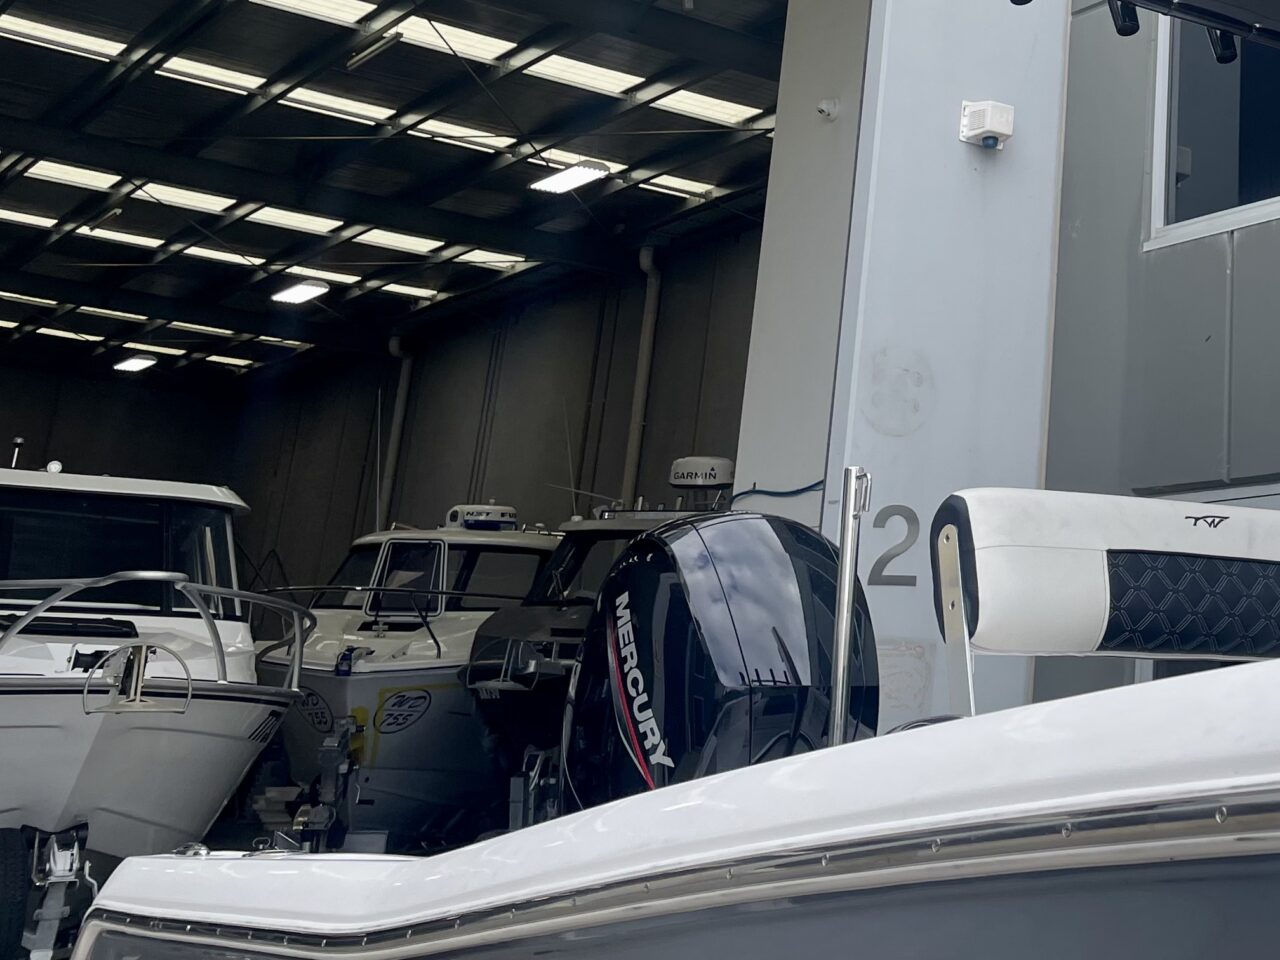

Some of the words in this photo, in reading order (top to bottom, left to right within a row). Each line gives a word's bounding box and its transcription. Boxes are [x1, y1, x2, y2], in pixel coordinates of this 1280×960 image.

[673, 471, 717, 480] GARMIN
[867, 504, 920, 587] 2
[616, 591, 675, 767] MERCURY
